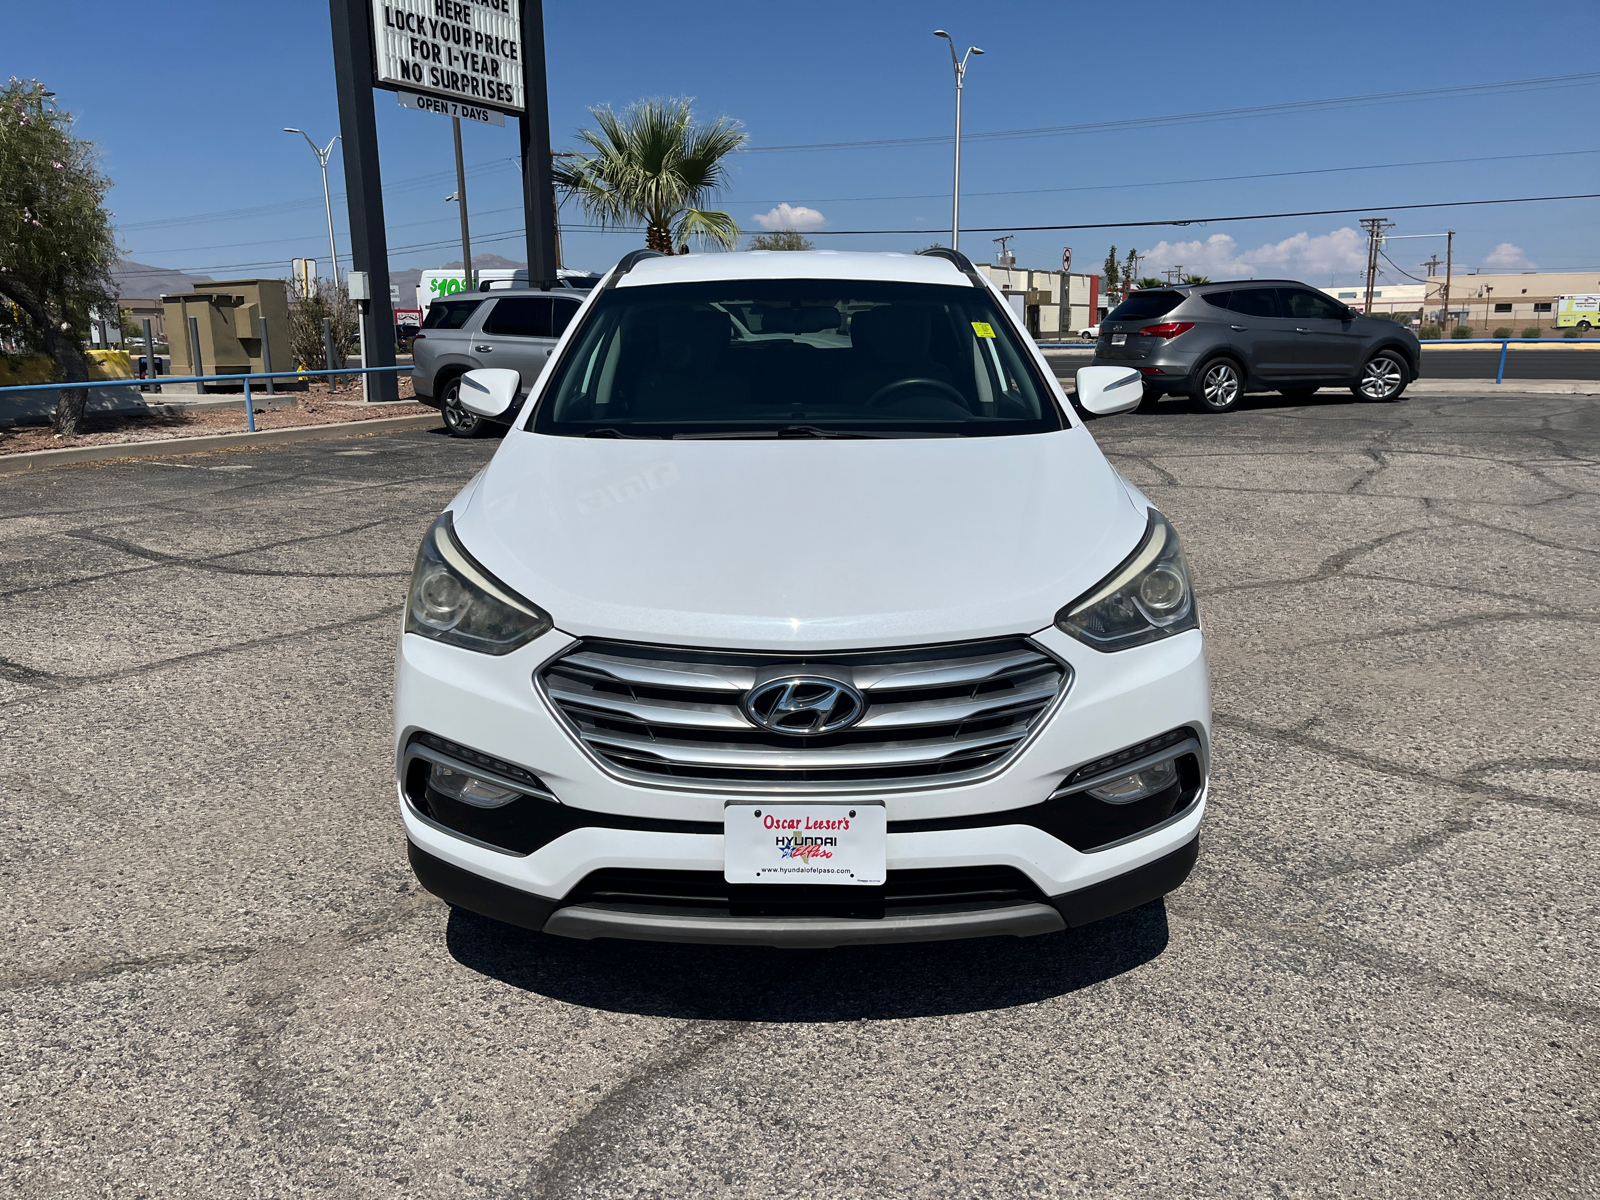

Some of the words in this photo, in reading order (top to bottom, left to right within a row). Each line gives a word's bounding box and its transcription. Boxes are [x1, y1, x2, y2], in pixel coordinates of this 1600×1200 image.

[435, 0, 471, 25] HERE
[385, 6, 427, 37] LOCK
[428, 17, 472, 48] YOUR
[475, 31, 518, 60] PRICE
[410, 36, 442, 64] FOR
[400, 59, 423, 83] NO
[431, 66, 513, 103] SURPRISES
[417, 96, 449, 114] OPEN
[451, 103, 459, 115] 7
[461, 105, 489, 122] DAYS
[763, 814, 802, 830] Oscar
[804, 816, 850, 831] Leeser's
[775, 836, 837, 847] HYUNDAI
[806, 843, 833, 859] Paso
[761, 866, 851, 875] www.hyundaiofelpaso.com
